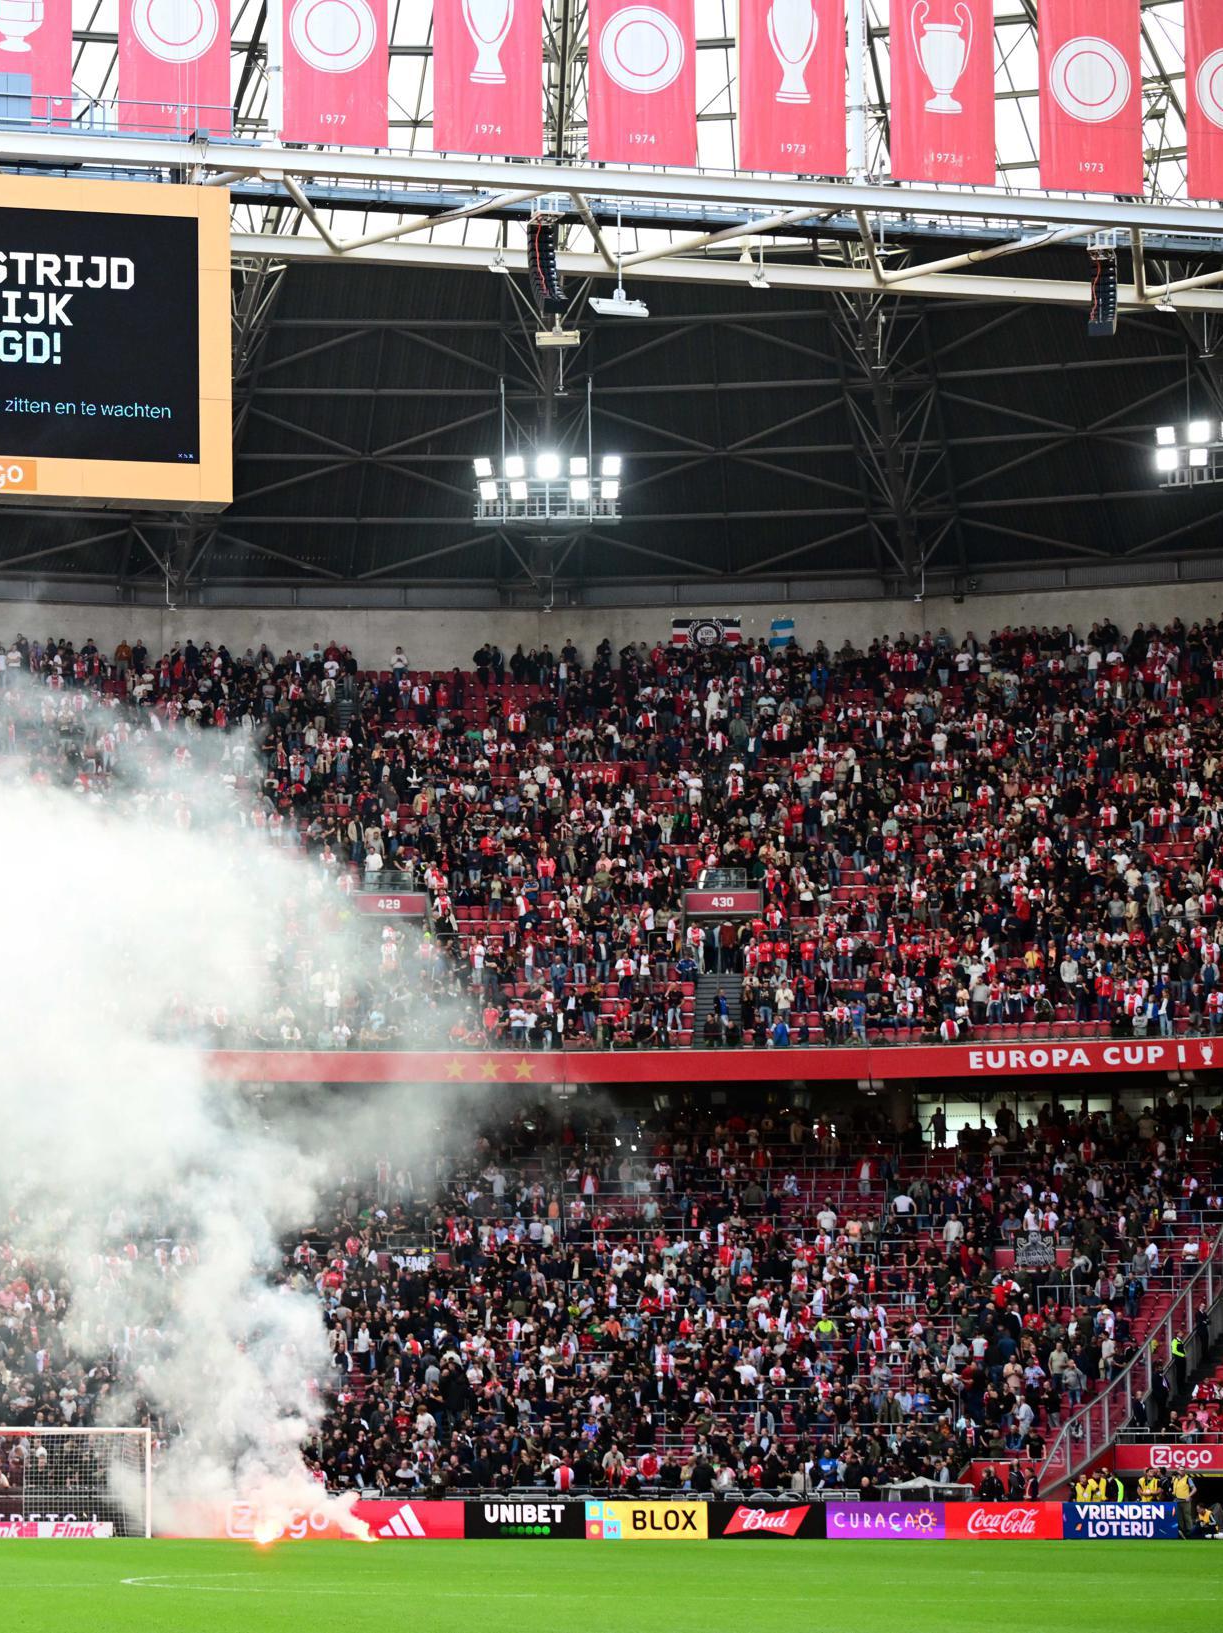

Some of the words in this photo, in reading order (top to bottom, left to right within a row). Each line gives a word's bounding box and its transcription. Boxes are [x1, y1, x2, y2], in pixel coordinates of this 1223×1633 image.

[320, 114, 346, 125] 1977
[474, 124, 502, 135] 1974
[629, 133, 656, 145] 1974
[780, 143, 806, 154] 1973
[931, 153, 956, 164] 1973
[1079, 162, 1104, 173] 1973
[5, 396, 50, 413] zitten
[55, 402, 76, 415] en
[80, 400, 96, 415] te
[100, 401, 171, 419] wachten
[377, 899, 401, 909] 429
[711, 896, 734, 907] 430
[968, 1048, 1090, 1069] EUROPA
[1103, 1045, 1164, 1065] CUP
[1150, 1446, 1213, 1468] Ziggo
[484, 1504, 565, 1523] UNIBET
[738, 1508, 788, 1529] Bud
[1077, 1504, 1165, 1520] VRIENDEN
[632, 1510, 697, 1531] BLOX
[967, 1508, 1039, 1534] Coca-Cola
[52, 1523, 98, 1537] Flink
[1088, 1520, 1154, 1538] LOTERIJ
